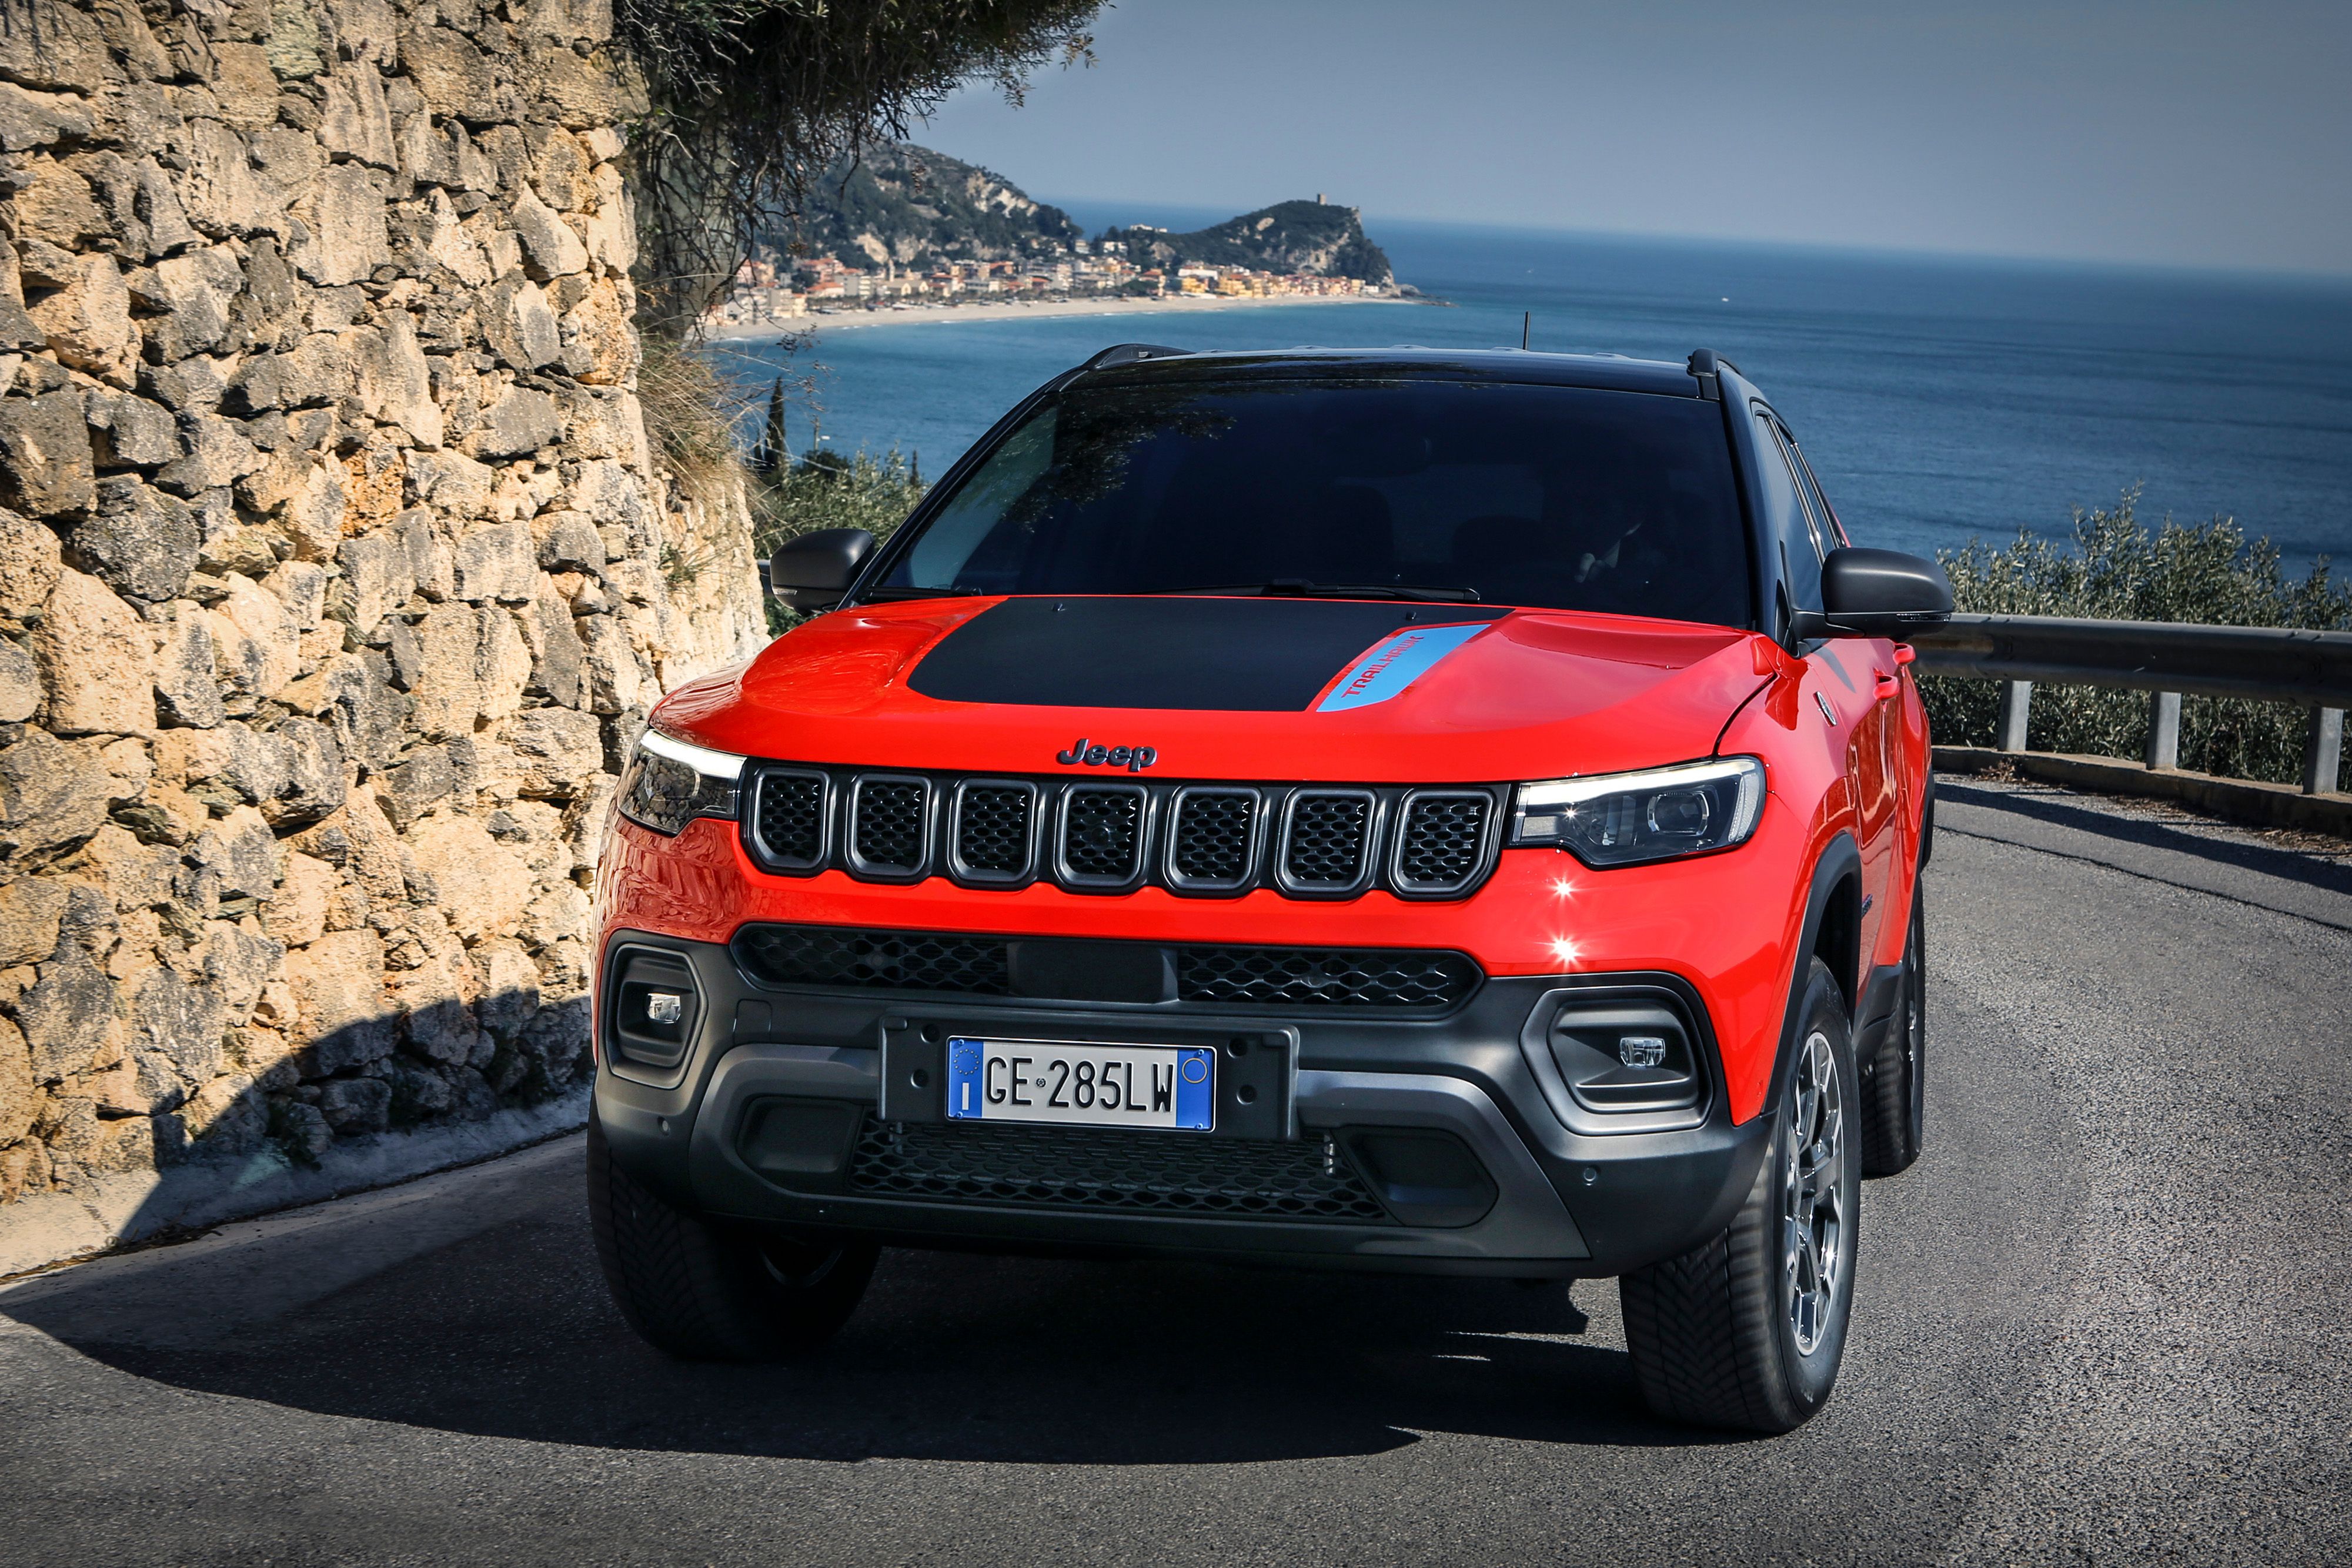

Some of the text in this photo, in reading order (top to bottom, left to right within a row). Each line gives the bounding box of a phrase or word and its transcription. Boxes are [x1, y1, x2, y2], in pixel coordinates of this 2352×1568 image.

[1341, 636, 1424, 698] TRAILHAWK
[1057, 738, 1157, 771] Jeep
[987, 1057, 1174, 1112] GE 285LW
